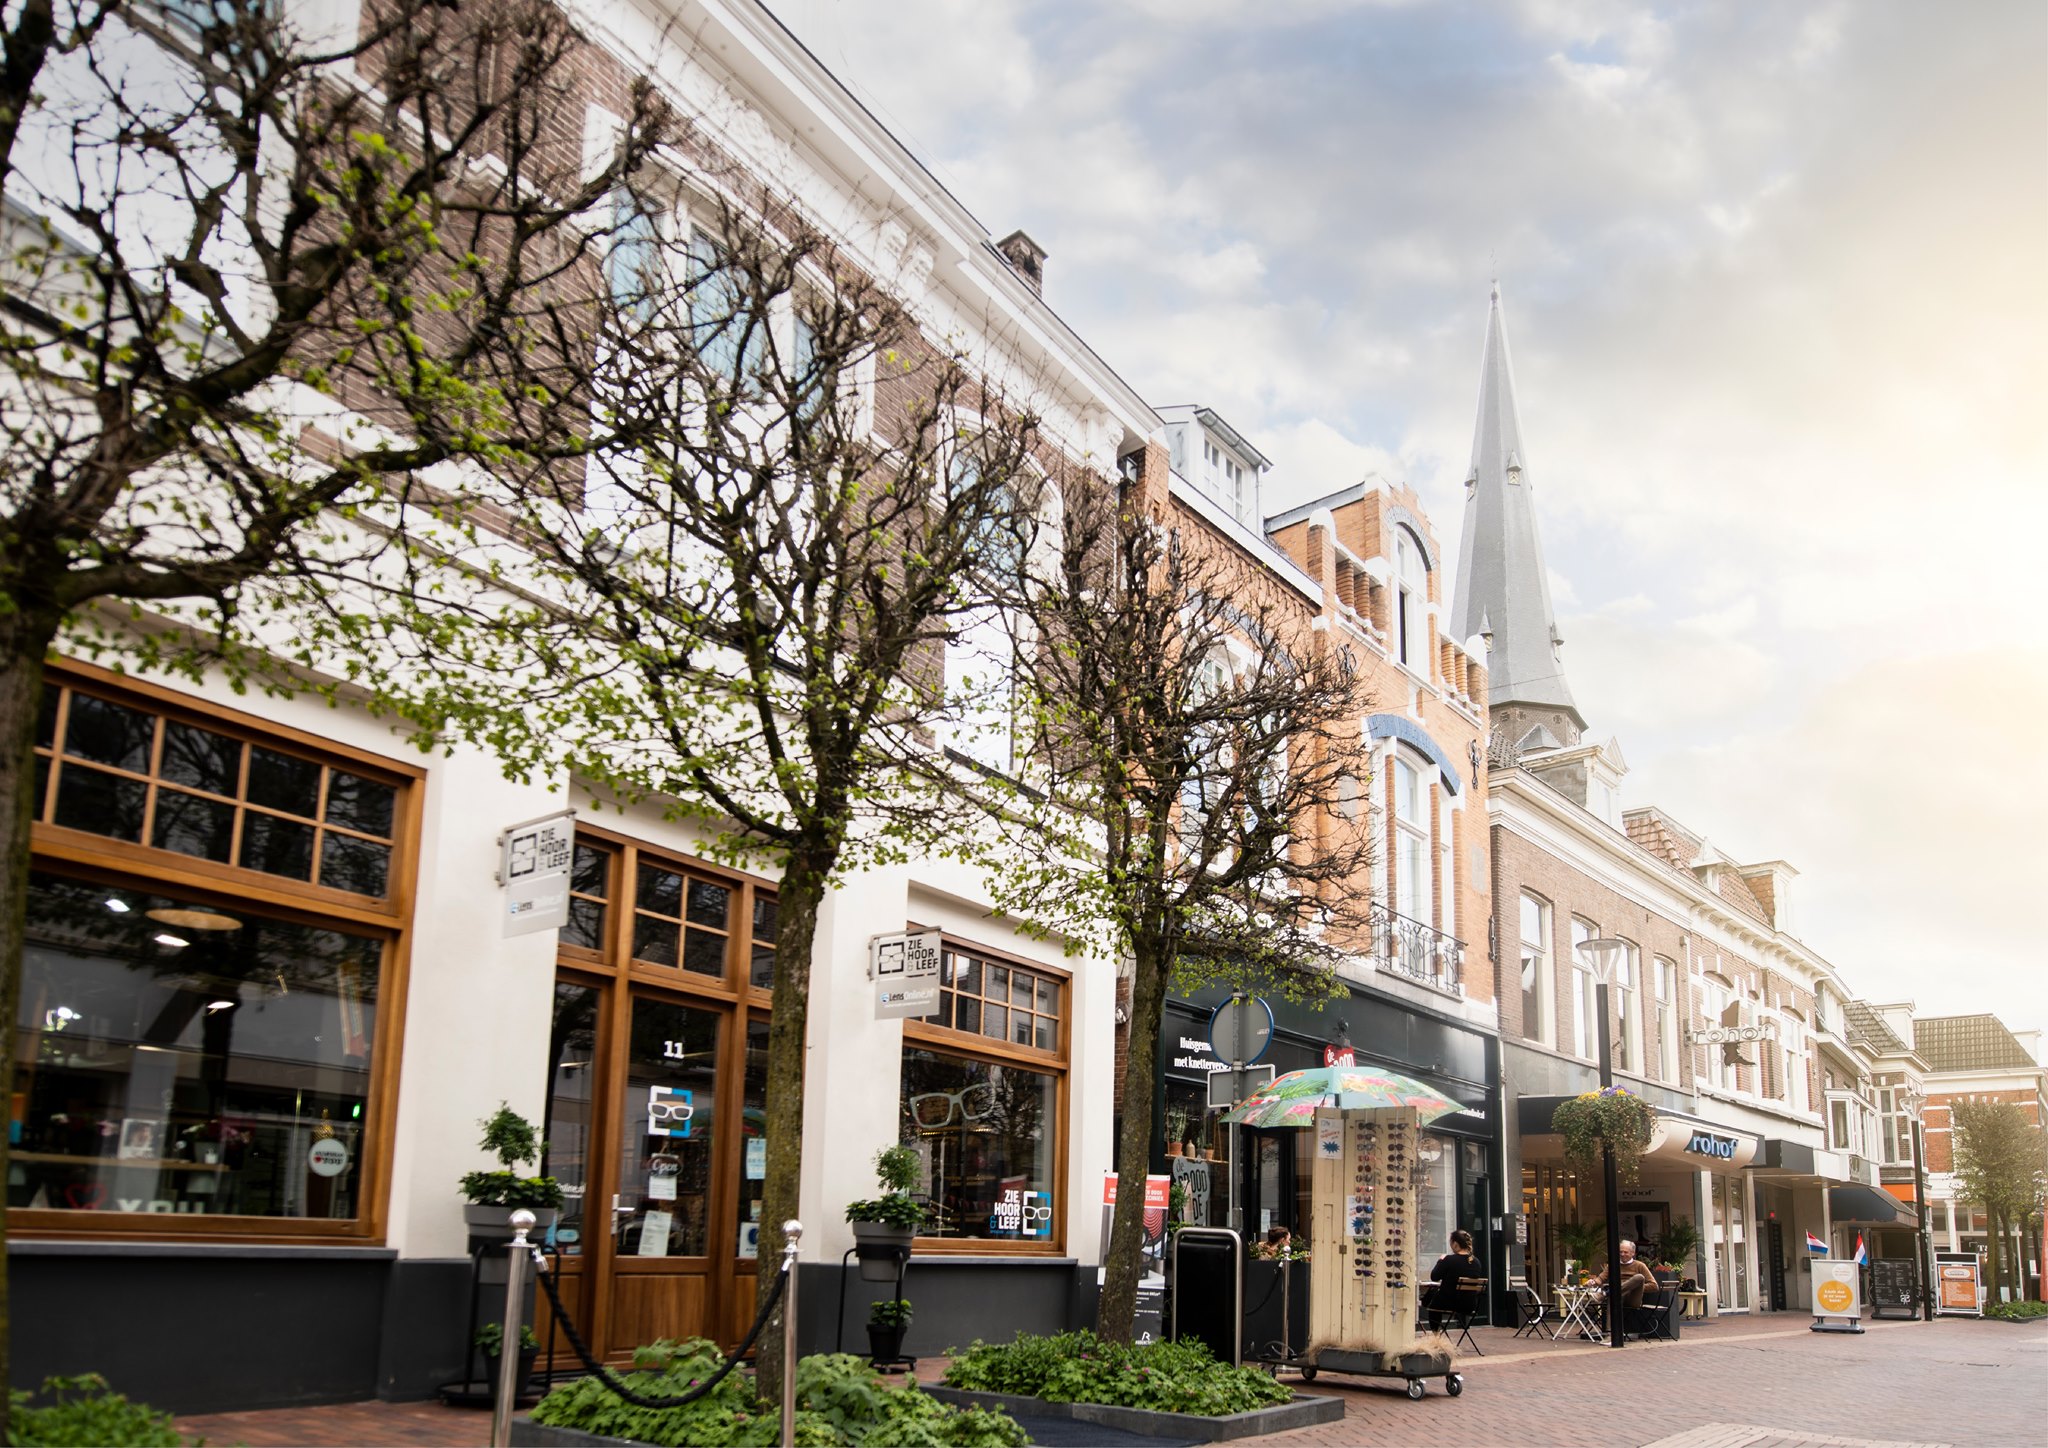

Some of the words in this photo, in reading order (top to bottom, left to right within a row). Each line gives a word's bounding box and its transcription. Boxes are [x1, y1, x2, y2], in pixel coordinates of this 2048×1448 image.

[541, 827, 555, 843] ZIE
[540, 838, 567, 856] HOOR
[547, 851, 570, 868] LEEF
[908, 939, 922, 950] ZIE
[907, 948, 934, 960] HOOR
[916, 958, 938, 970] LEEF
[664, 1040, 684, 1059] 11
[1174, 1057, 1187, 1067] met
[1693, 1133, 1739, 1159] rohof
[652, 1158, 678, 1175] Open
[994, 1202, 1020, 1216] HOOR
[998, 1216, 1020, 1230] LEEF
